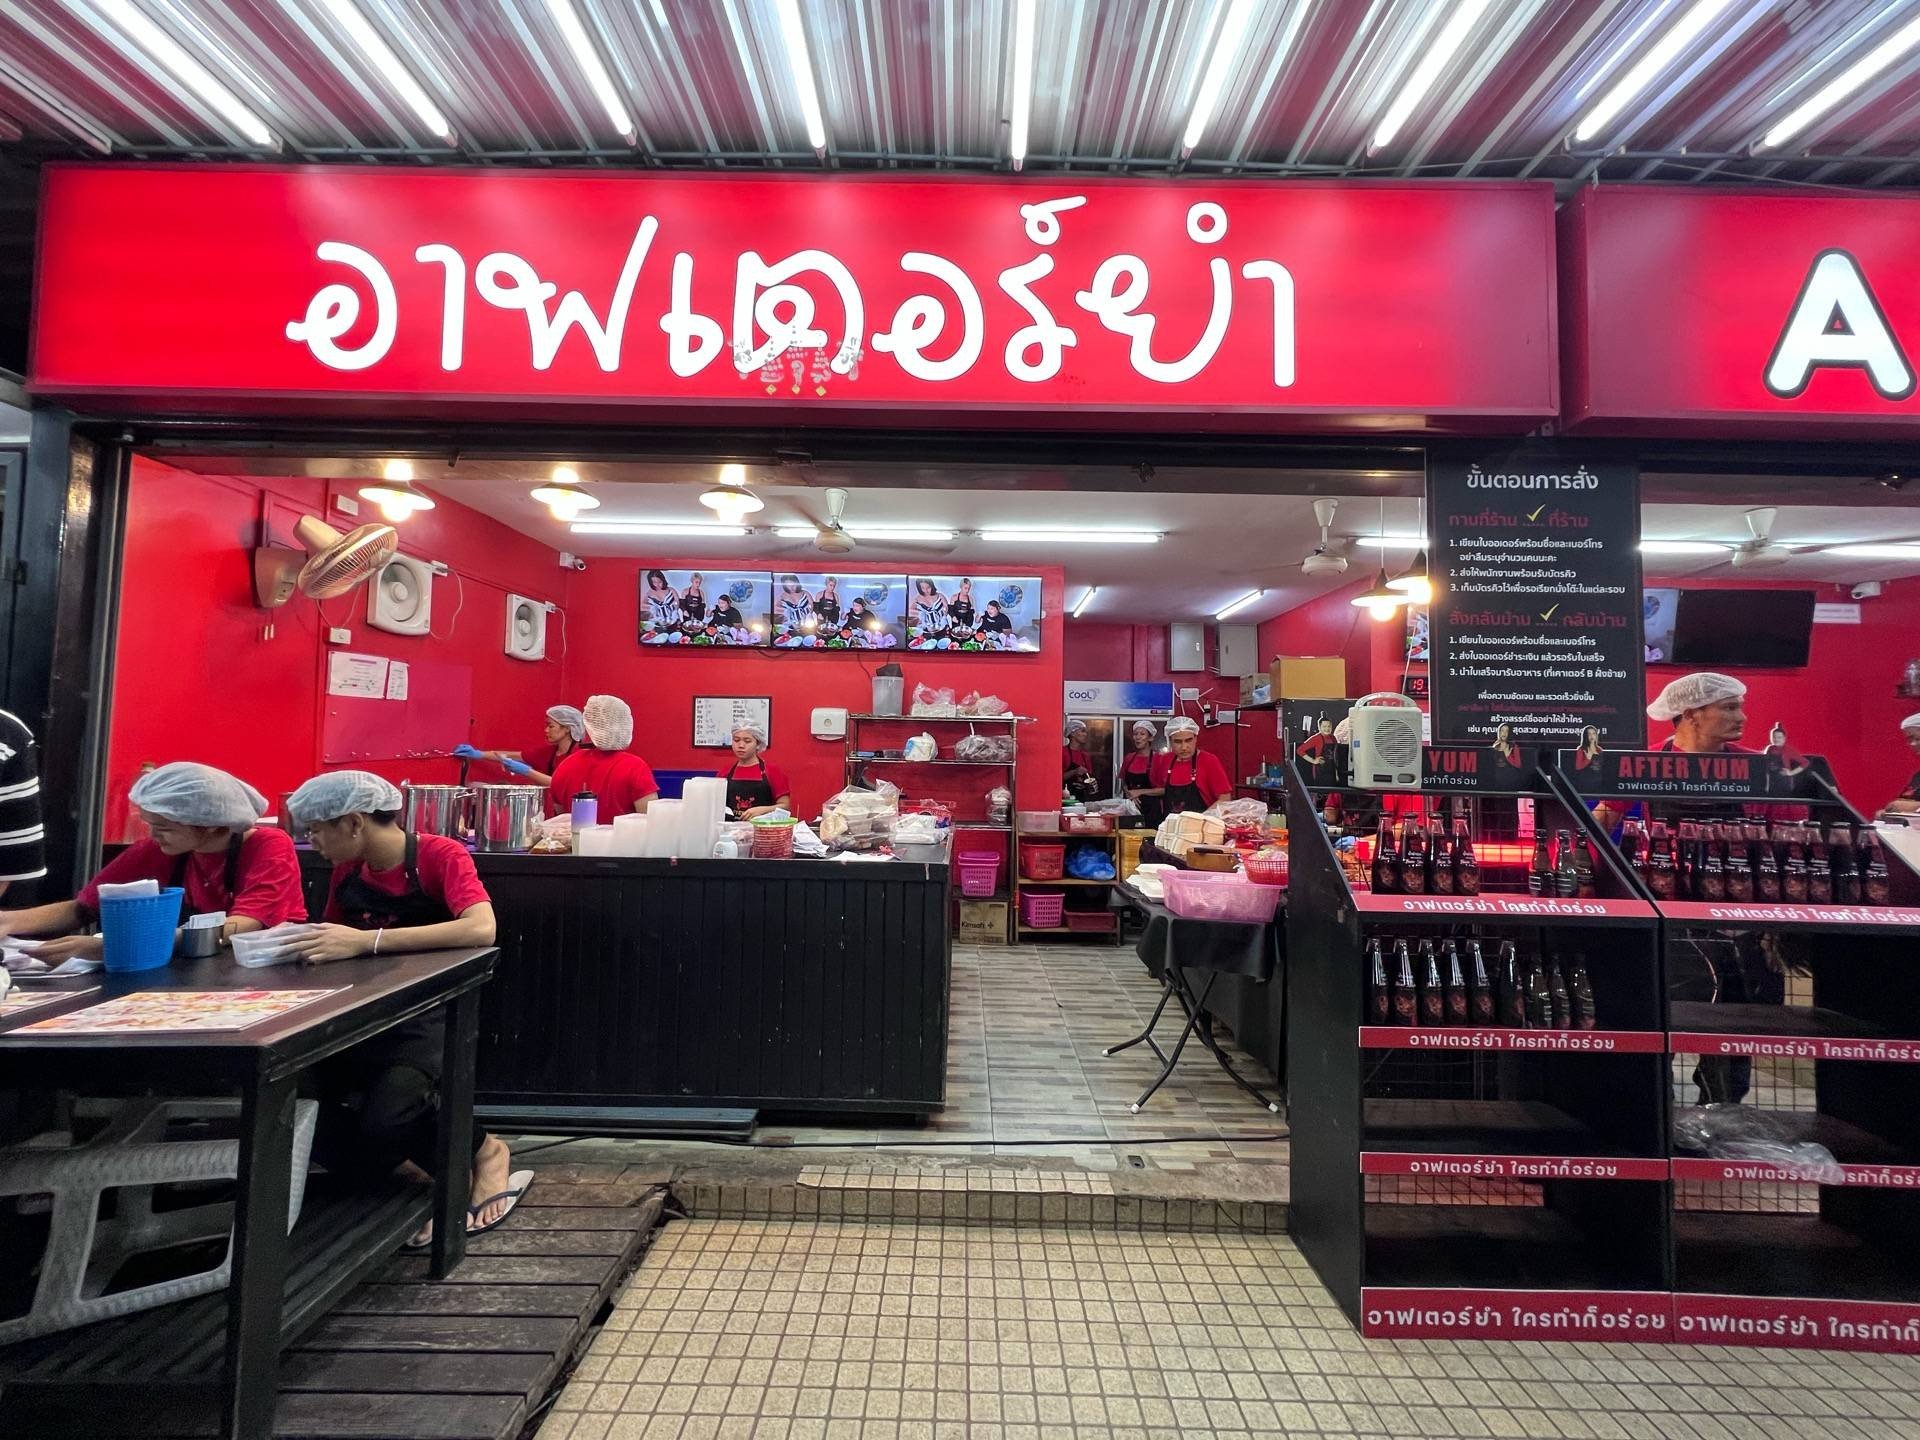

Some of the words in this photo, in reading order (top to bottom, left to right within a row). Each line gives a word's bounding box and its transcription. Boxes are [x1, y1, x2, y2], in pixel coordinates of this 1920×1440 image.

[285, 195, 1295, 388] อาฟเตอร์ยำ
[1466, 463, 1599, 490] ขั้นตอนการสั่ง
[1449, 539, 1458, 547] 1.
[1449, 569, 1458, 577] 2.
[1450, 583, 1459, 592] 3.
[1449, 636, 1457, 644] 1.
[1449, 652, 1457, 660] 2.
[1449, 668, 1458, 676] 3.
[1428, 750, 1478, 773] YUM
[1618, 756, 1690, 779] AFTER
[1697, 757, 1750, 780] YUM
[1422, 774, 1477, 786] รทำก็อร่อย
[1617, 781, 1678, 791] อาฟเตอร์ยำ
[1403, 899, 1496, 912] อาฟเตอร์ยำ
[1498, 899, 1606, 914] ใครทำก็อร่อย
[1709, 906, 1807, 920] อาฟเตอร์ยำ
[1409, 1032, 1501, 1047] อาฟเตอร์ยำ
[1508, 1032, 1615, 1050] ใครทำก็อร่อย
[1719, 1041, 1817, 1056] อาฟเตอร์ยำ
[1410, 1159, 1504, 1174] อาฟเตอร์ยำ
[1510, 1160, 1617, 1176] ใครทำก็อร่อย
[1368, 1306, 1502, 1327] อาฟเตอร์ยำ
[1511, 1306, 1666, 1329] ใครทำก็อร่อย
[1679, 1314, 1818, 1336] อาฟเตอร์ยำ
